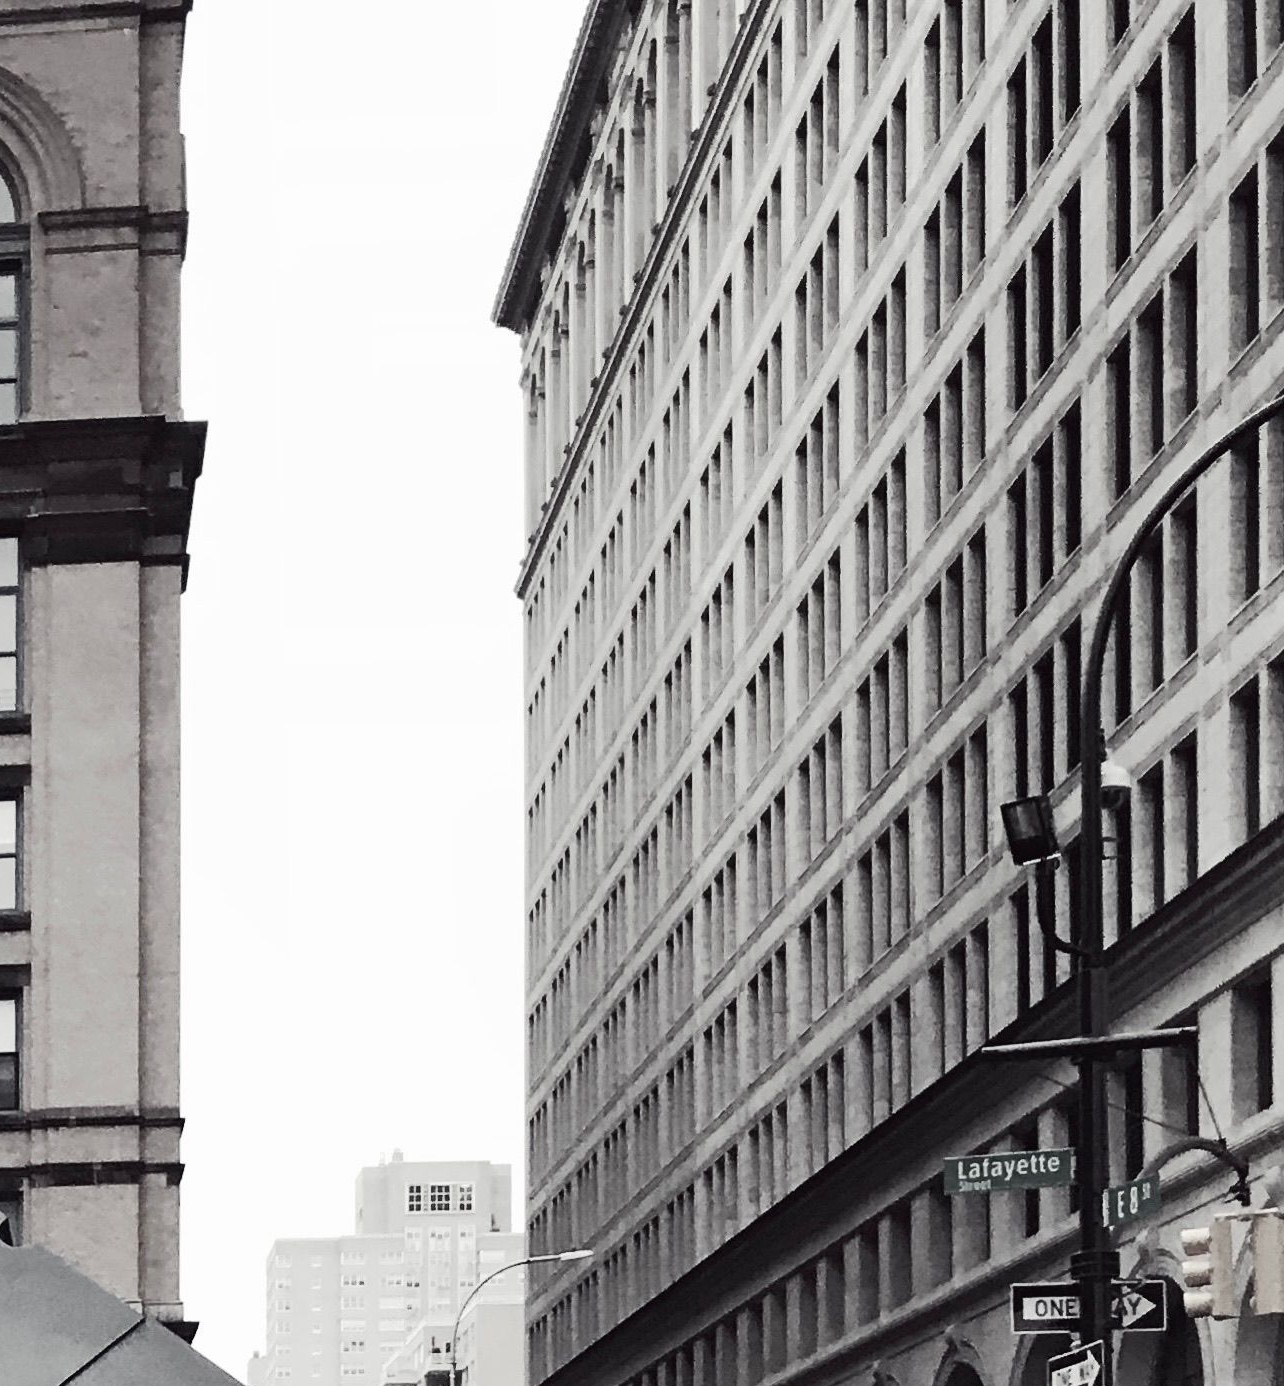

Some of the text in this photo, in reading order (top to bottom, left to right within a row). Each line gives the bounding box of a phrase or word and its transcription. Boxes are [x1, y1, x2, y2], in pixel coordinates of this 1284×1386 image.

[958, 1154, 1060, 1181] Lafayette
[959, 1179, 991, 1192] Street
[1117, 1191, 1124, 1218] E
[1129, 1187, 1138, 1214] 8
[1034, 1298, 1078, 1317] ONE
